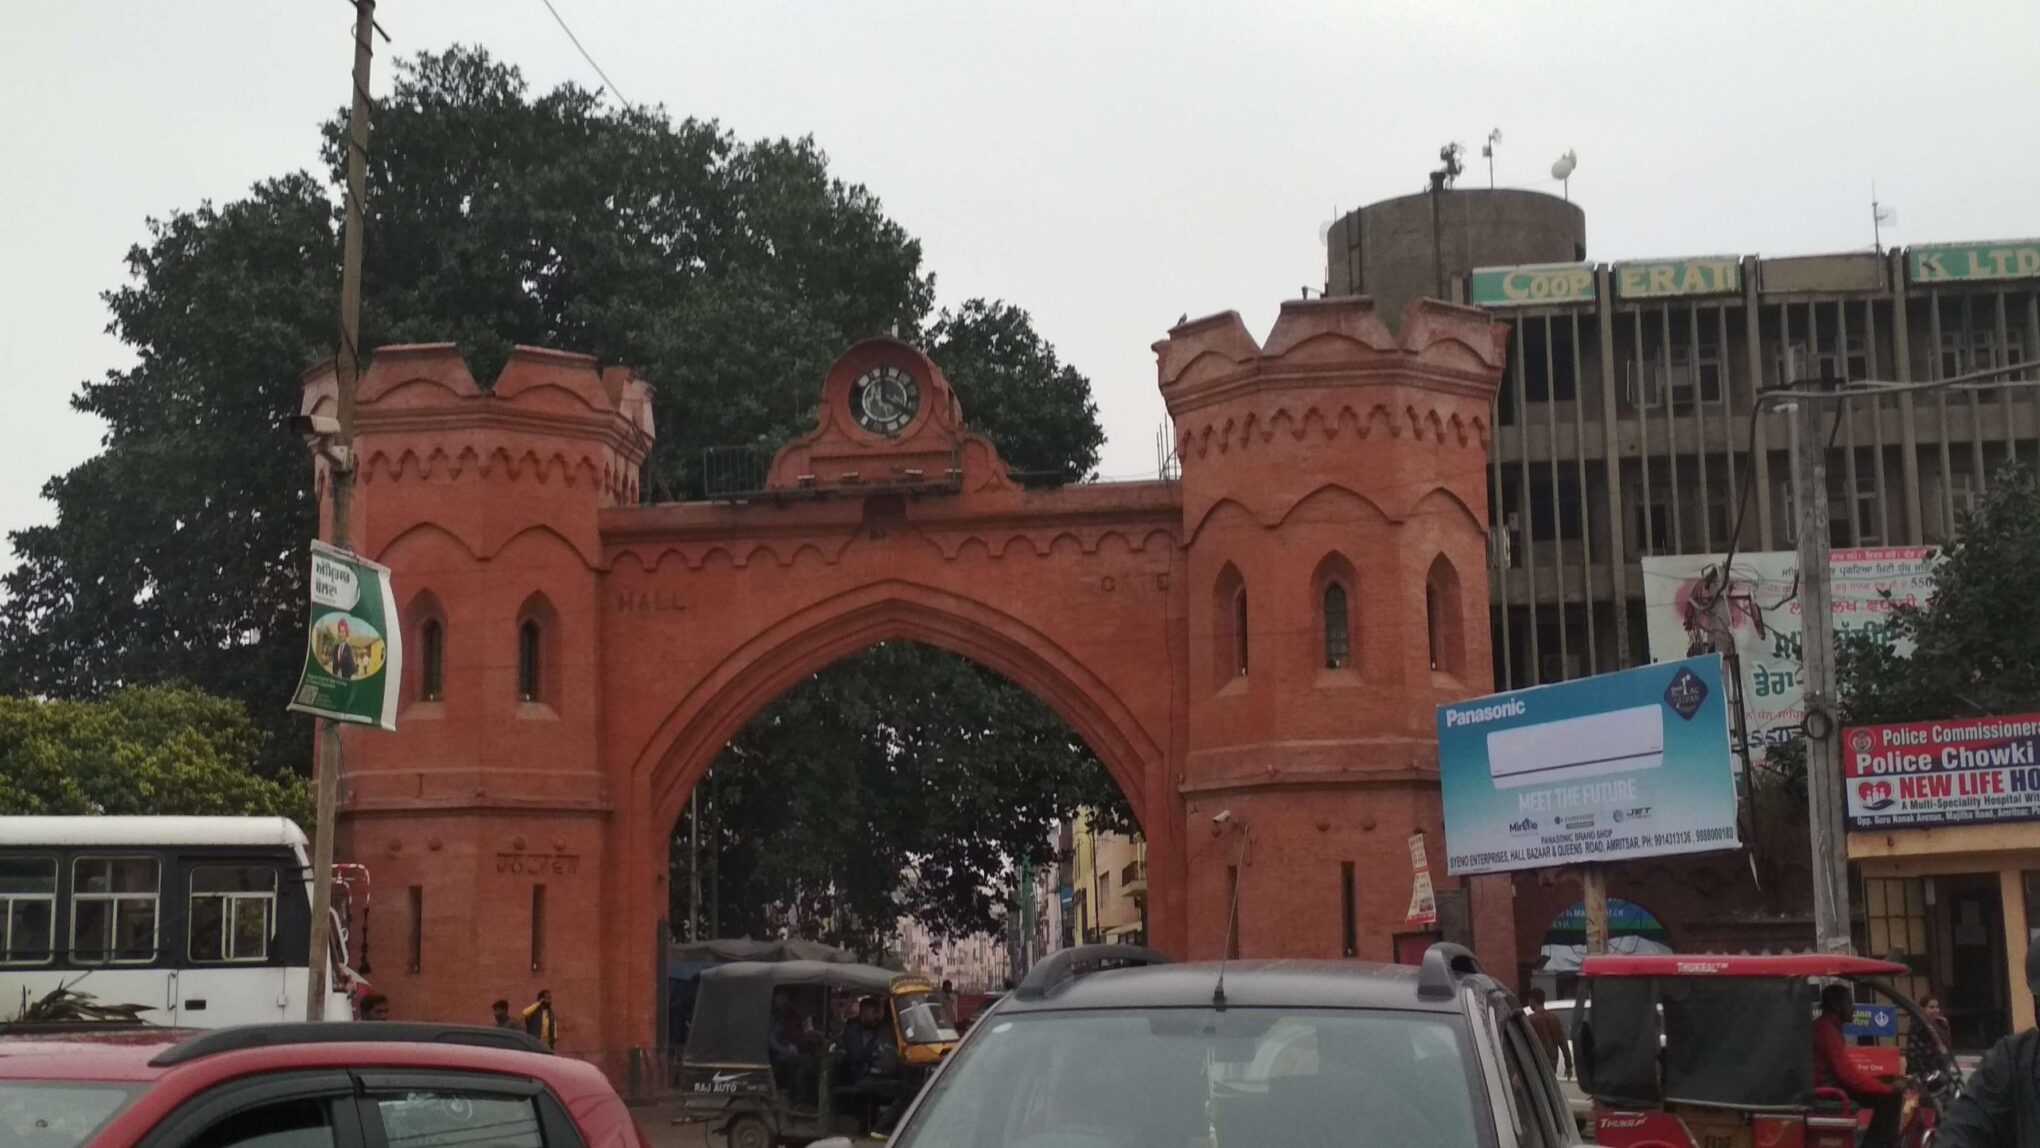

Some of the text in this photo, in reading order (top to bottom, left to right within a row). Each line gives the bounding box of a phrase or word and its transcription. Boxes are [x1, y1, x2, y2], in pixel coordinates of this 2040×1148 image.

[1446, 697, 1526, 728] Panasonic
[1882, 720, 2040, 747] Police Commissioner
[1856, 741, 2034, 776] Police Chowki
[1519, 778, 1637, 814] MEET THE FUTURE
[1900, 774, 1953, 799] NEW
[1958, 770, 2004, 796] LIFE
[1901, 799, 1908, 811] A
[1910, 795, 1981, 811] Multi-Speciality
[1984, 793, 2022, 807] Hospital
[1857, 815, 1873, 827] Opp.
[1875, 815, 1891, 825] Guru
[1893, 814, 1915, 824] Nanak
[1541, 832, 1573, 845] PANASONIC
[1574, 830, 1596, 842] BRAND
[1596, 828, 1613, 840] SHOP
[1510, 848, 1526, 861] HALL
[1527, 845, 1551, 859] BAZAAR
[1558, 842, 1582, 856] QUEENS
[713, 1082, 737, 1093] AUTO
